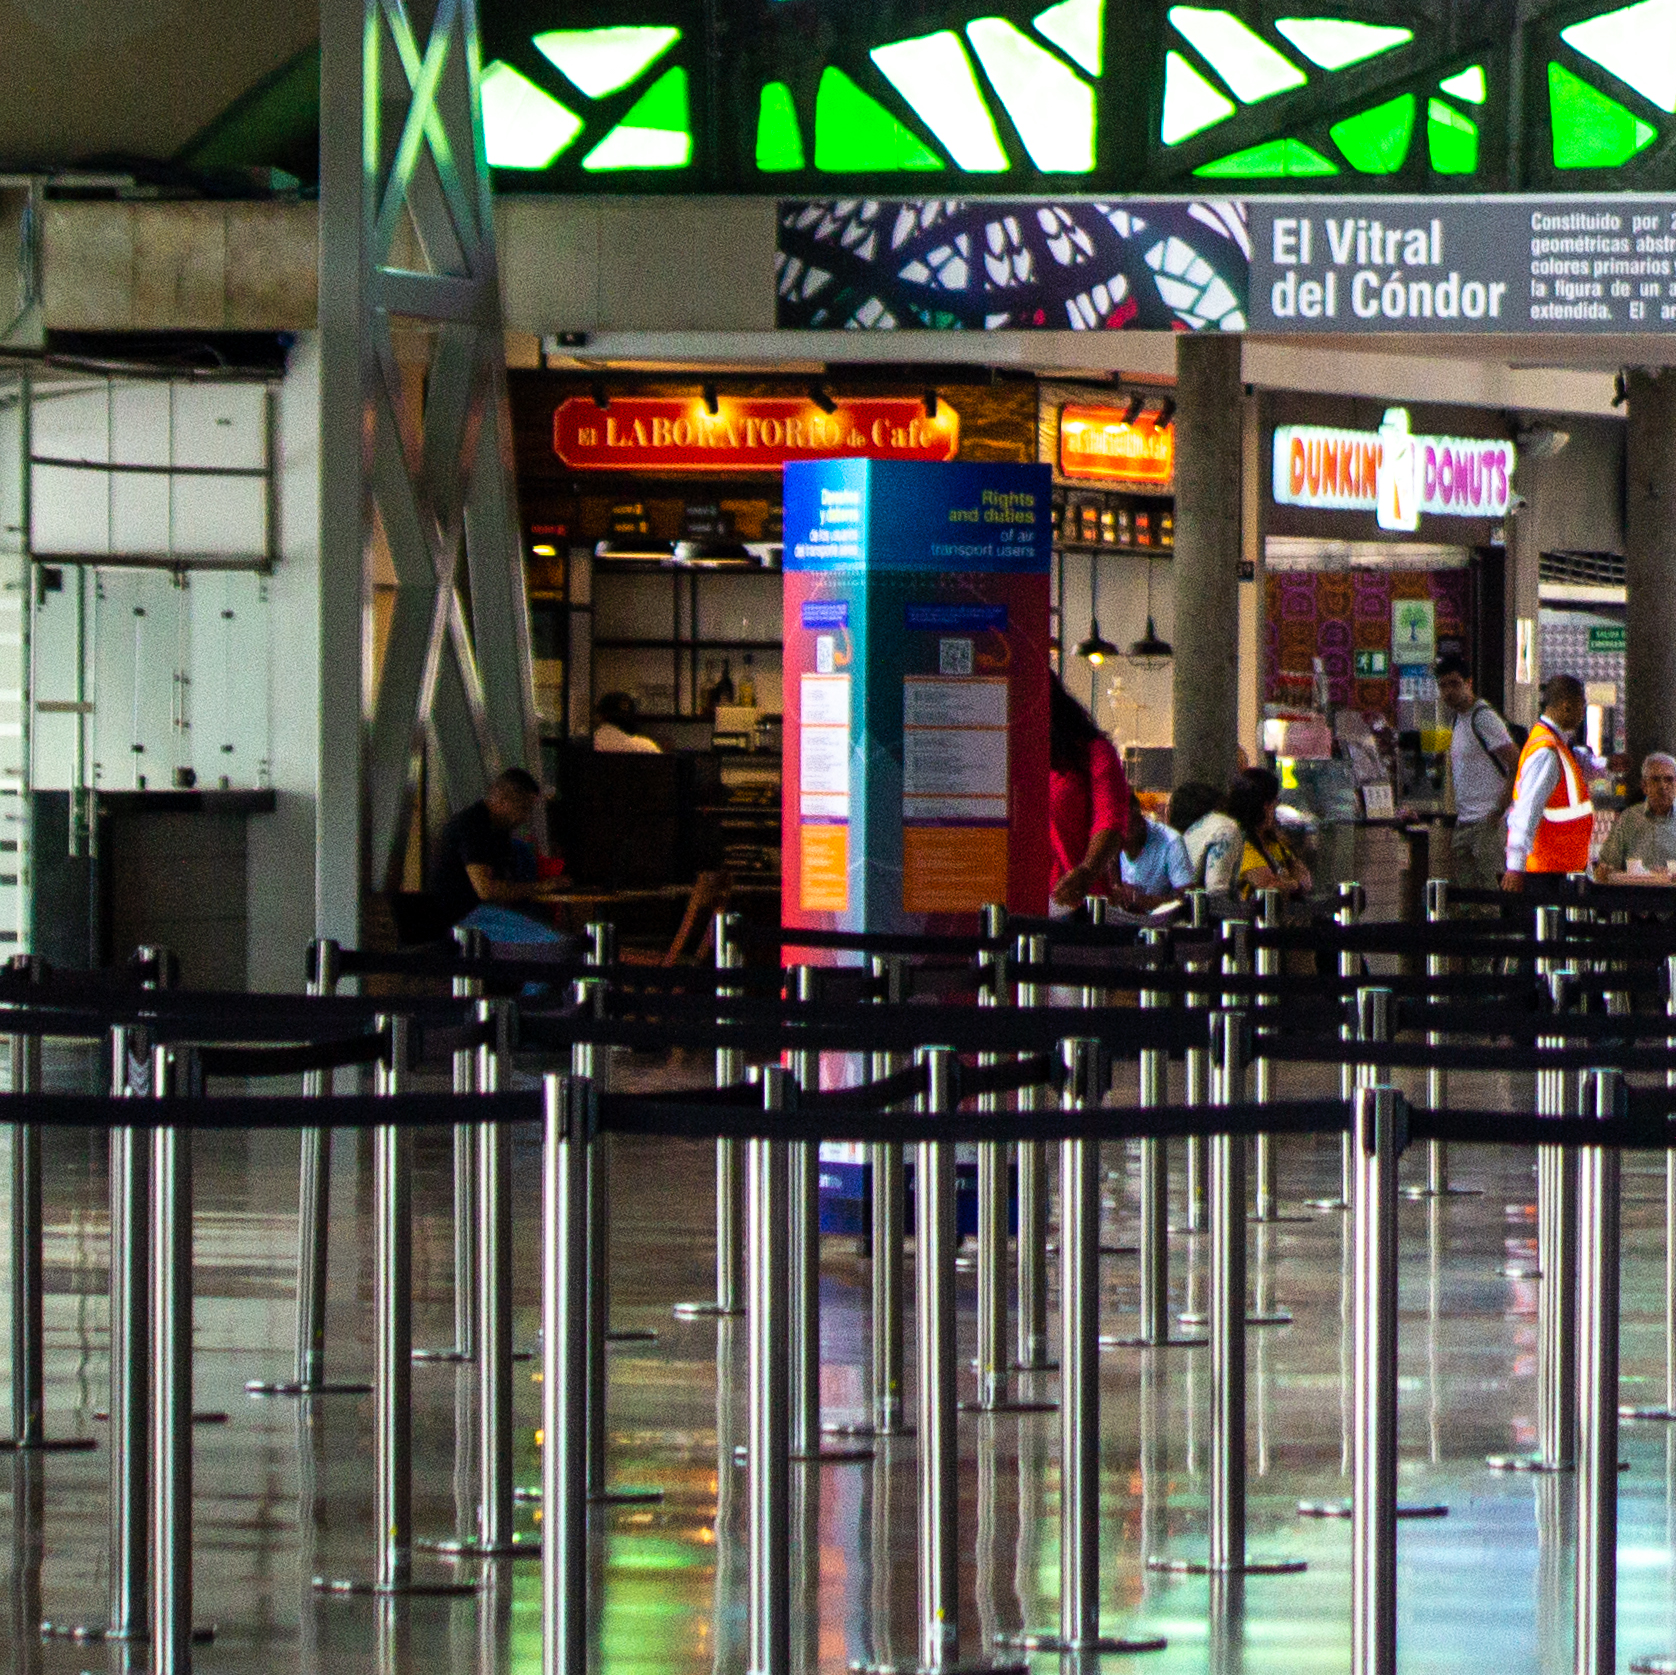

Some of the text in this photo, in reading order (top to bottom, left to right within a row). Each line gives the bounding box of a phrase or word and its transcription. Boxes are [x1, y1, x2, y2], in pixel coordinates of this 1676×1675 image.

[1531, 212, 1622, 230] Constituido
[1632, 215, 1659, 235] por
[1273, 218, 1442, 265] El Vitral
[1530, 235, 1630, 258] geométricas
[1530, 258, 1590, 275] colores
[1593, 258, 1671, 280] primarios
[1271, 270, 1506, 318] del Cóndor
[1530, 280, 1547, 297] la
[1554, 280, 1603, 302] figura
[1610, 280, 1631, 297] de
[1639, 282, 1661, 297] un
[1530, 302, 1612, 320] extendida.
[1629, 302, 1645, 320] El
[606, 416, 841, 449] LABORATORIO
[846, 426, 867, 448] de
[1423, 444, 1507, 507] DONUTS
[982, 489, 1035, 508] Rights
[948, 507, 980, 522] and
[931, 543, 1035, 558] transport users
